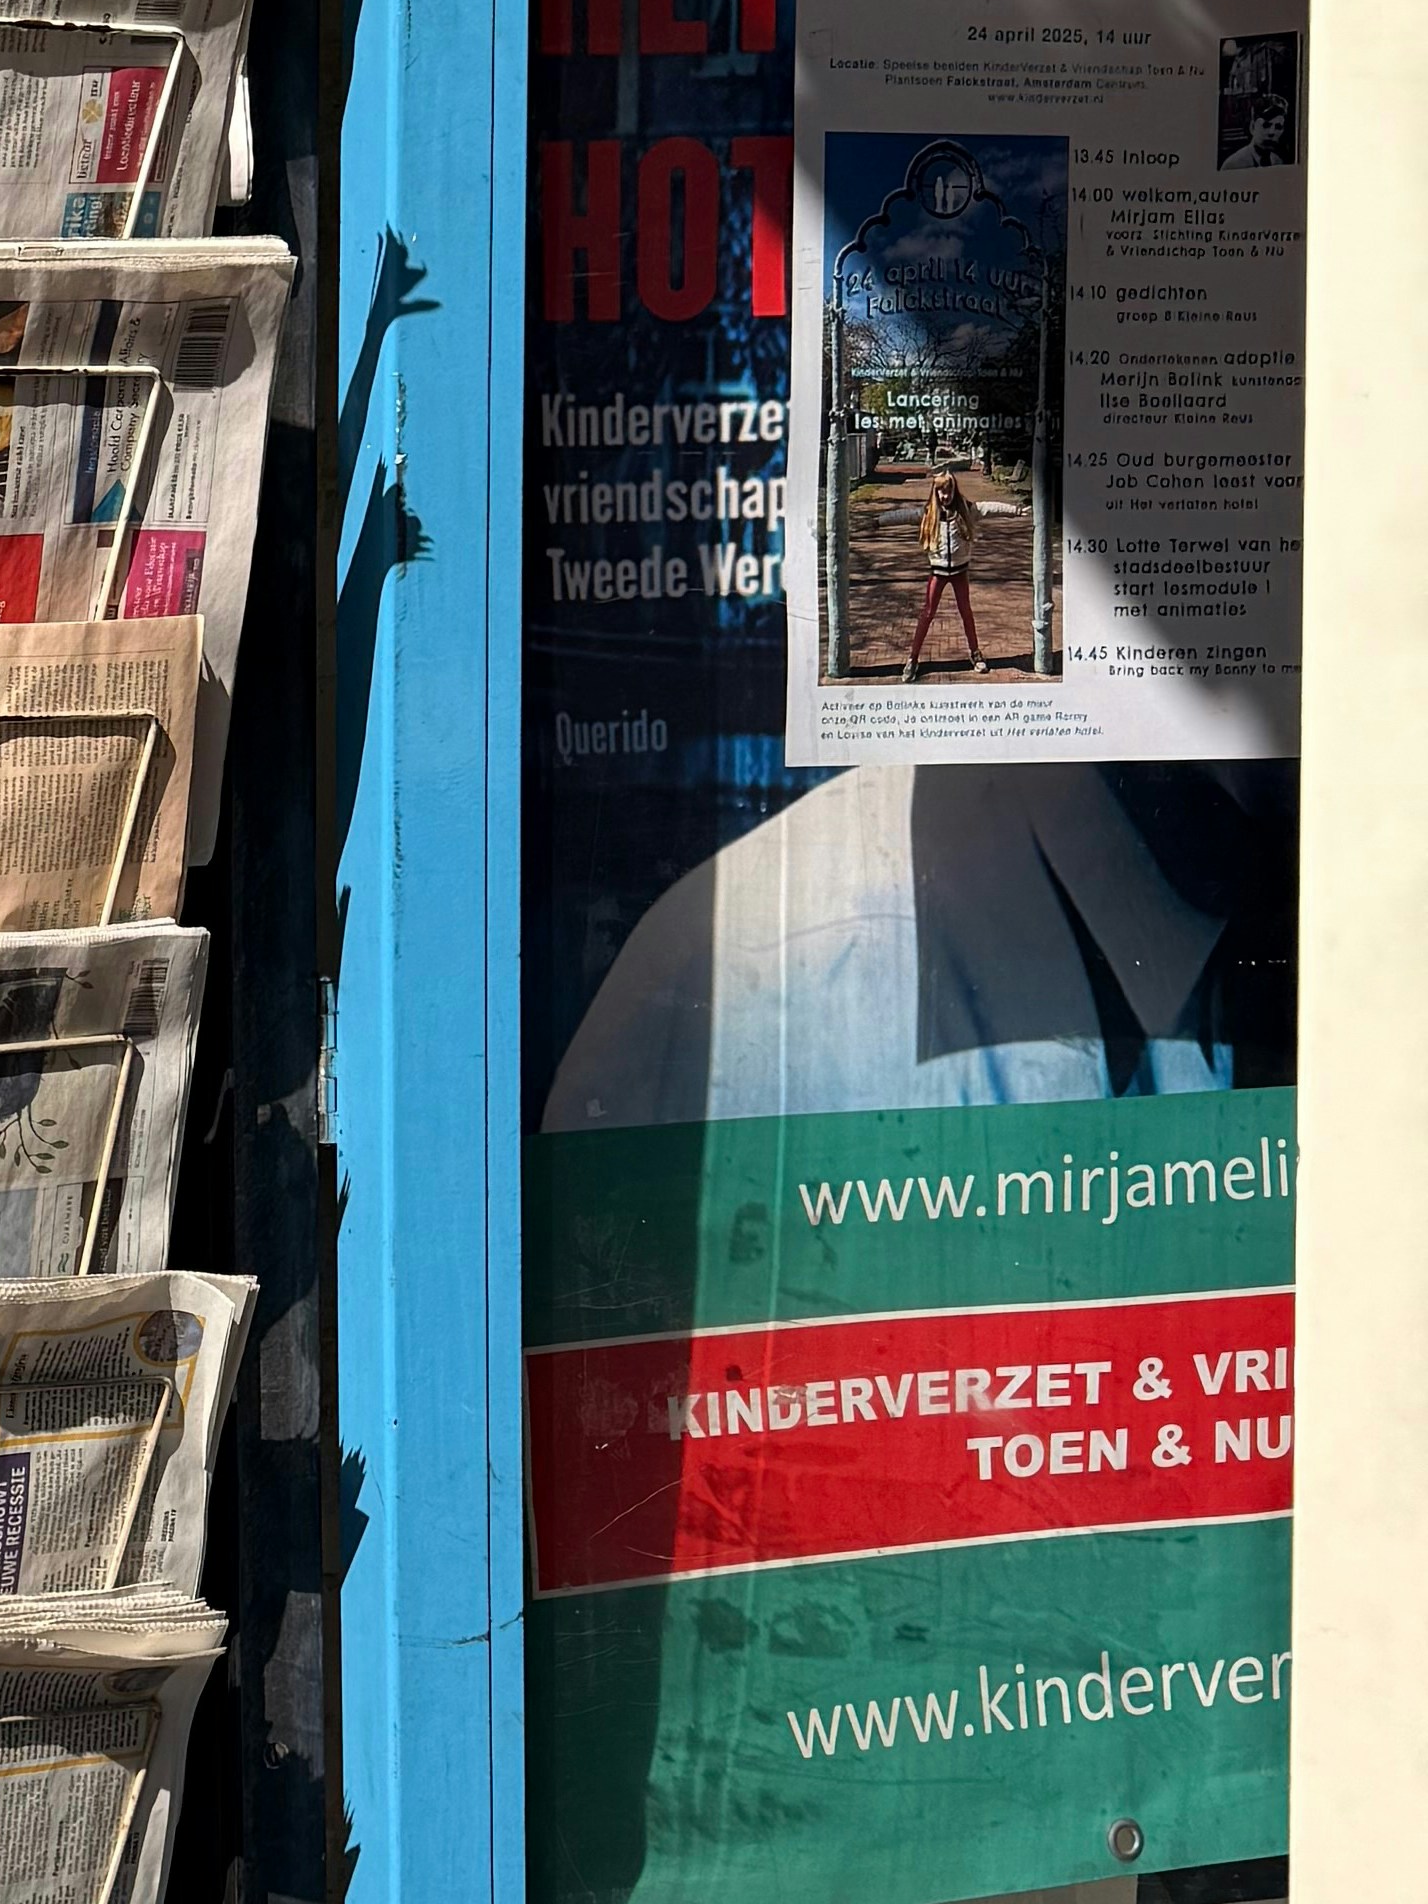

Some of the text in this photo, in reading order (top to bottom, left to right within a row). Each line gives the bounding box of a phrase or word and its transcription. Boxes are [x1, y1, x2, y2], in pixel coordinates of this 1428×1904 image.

[967, 27, 1152, 46] 24 april 2025, 14 uur
[1073, 148, 1180, 168] 13.45 Inloop
[1110, 207, 1176, 228] Mirjam
[1116, 284, 1208, 303] gedichten
[1100, 371, 1223, 388] Merijn Balink
[887, 391, 980, 410] Lancering
[1116, 451, 1292, 470] Oud burgemeester
[544, 466, 786, 532] vriendschap
[1067, 537, 1229, 555] 14.30 Lotte Terwel
[546, 547, 689, 601] Tweede
[1114, 558, 1271, 576] stadsdeelbestuur
[1163, 580, 1258, 596] lesmodule
[1157, 602, 1247, 618] animaties
[1068, 644, 1267, 662] 14.45 Kinderen zingen
[555, 709, 668, 766] Querido
[665, 1360, 1112, 1442] KINDERVERZET
[1132, 1355, 1173, 1402] &
[966, 1414, 1293, 1482] TOEN & NU
